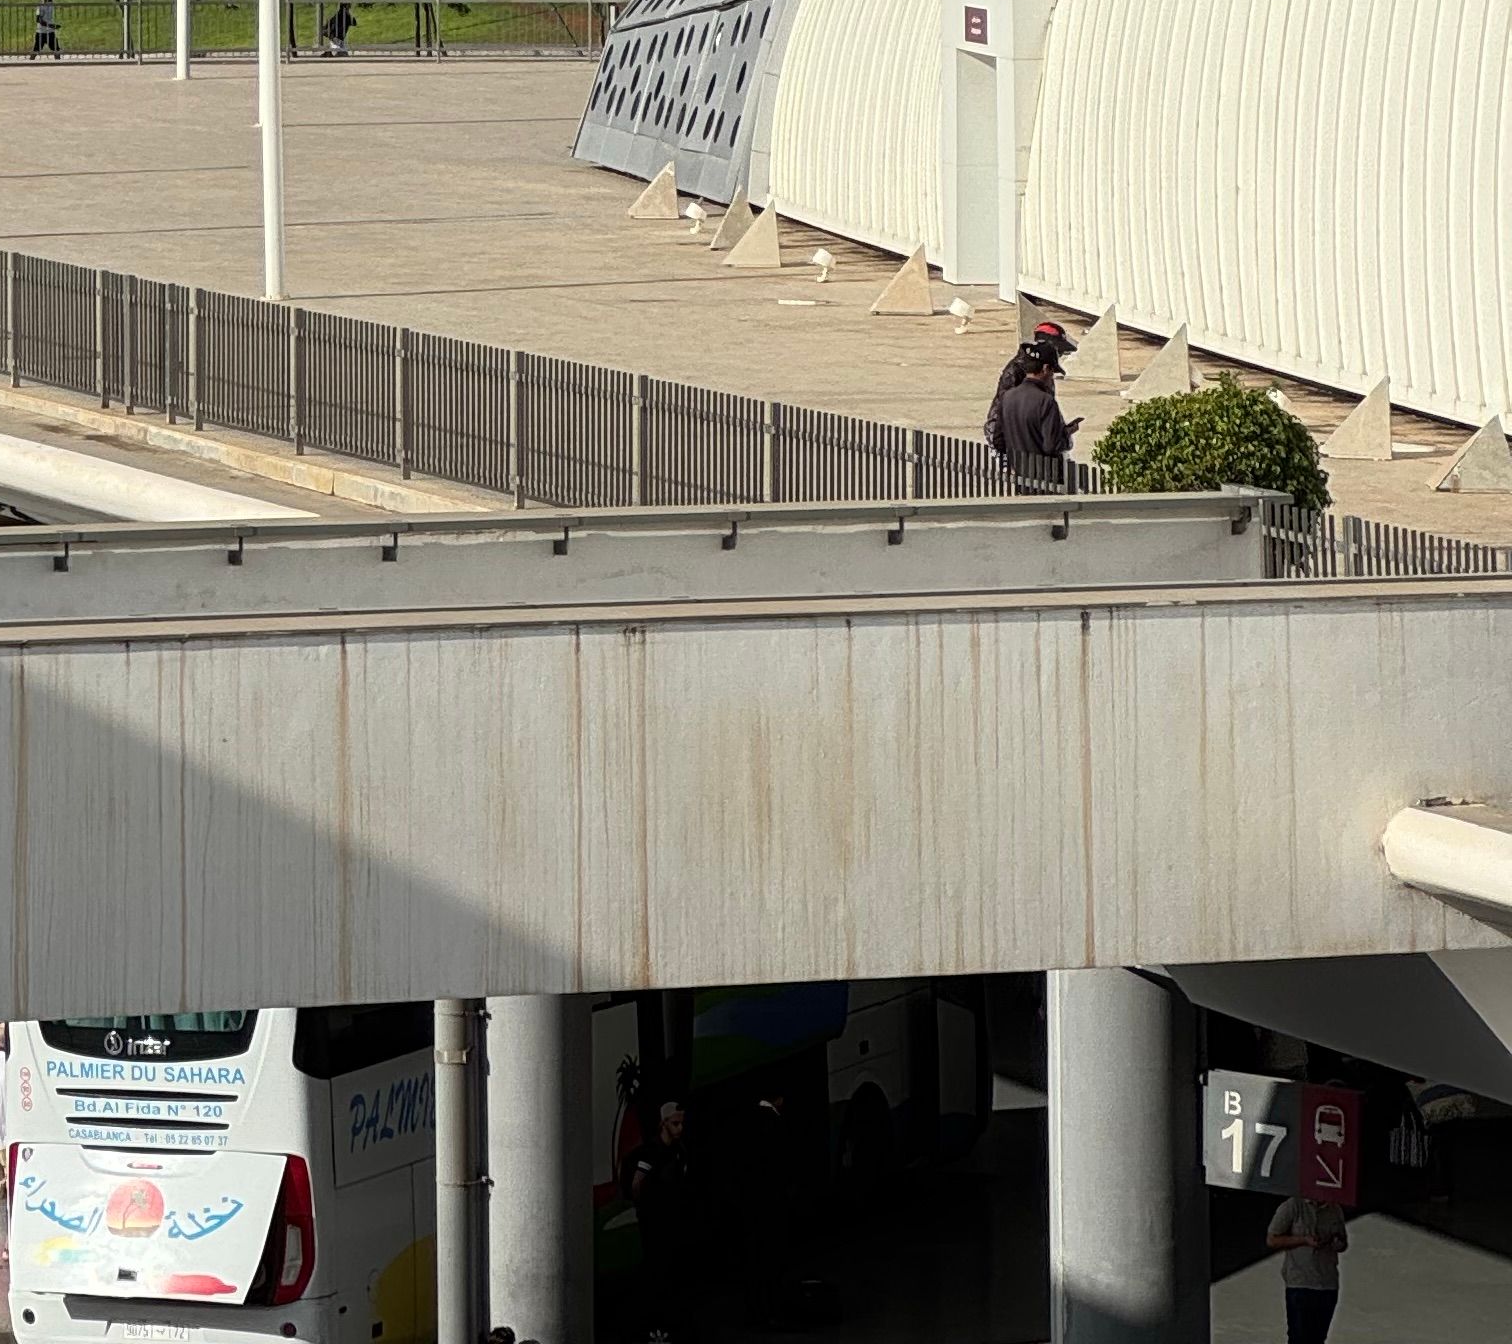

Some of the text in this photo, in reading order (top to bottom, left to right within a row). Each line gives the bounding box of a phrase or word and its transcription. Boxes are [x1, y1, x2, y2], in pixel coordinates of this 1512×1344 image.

[46, 1060, 245, 1085] PALMIER DU SAHARA
[125, 1102, 161, 1116] Fida
[192, 1105, 223, 1118] 120
[1224, 1090, 1242, 1116] B
[68, 1127, 132, 1142] CASABLANCA
[1221, 1118, 1288, 1178] 17
